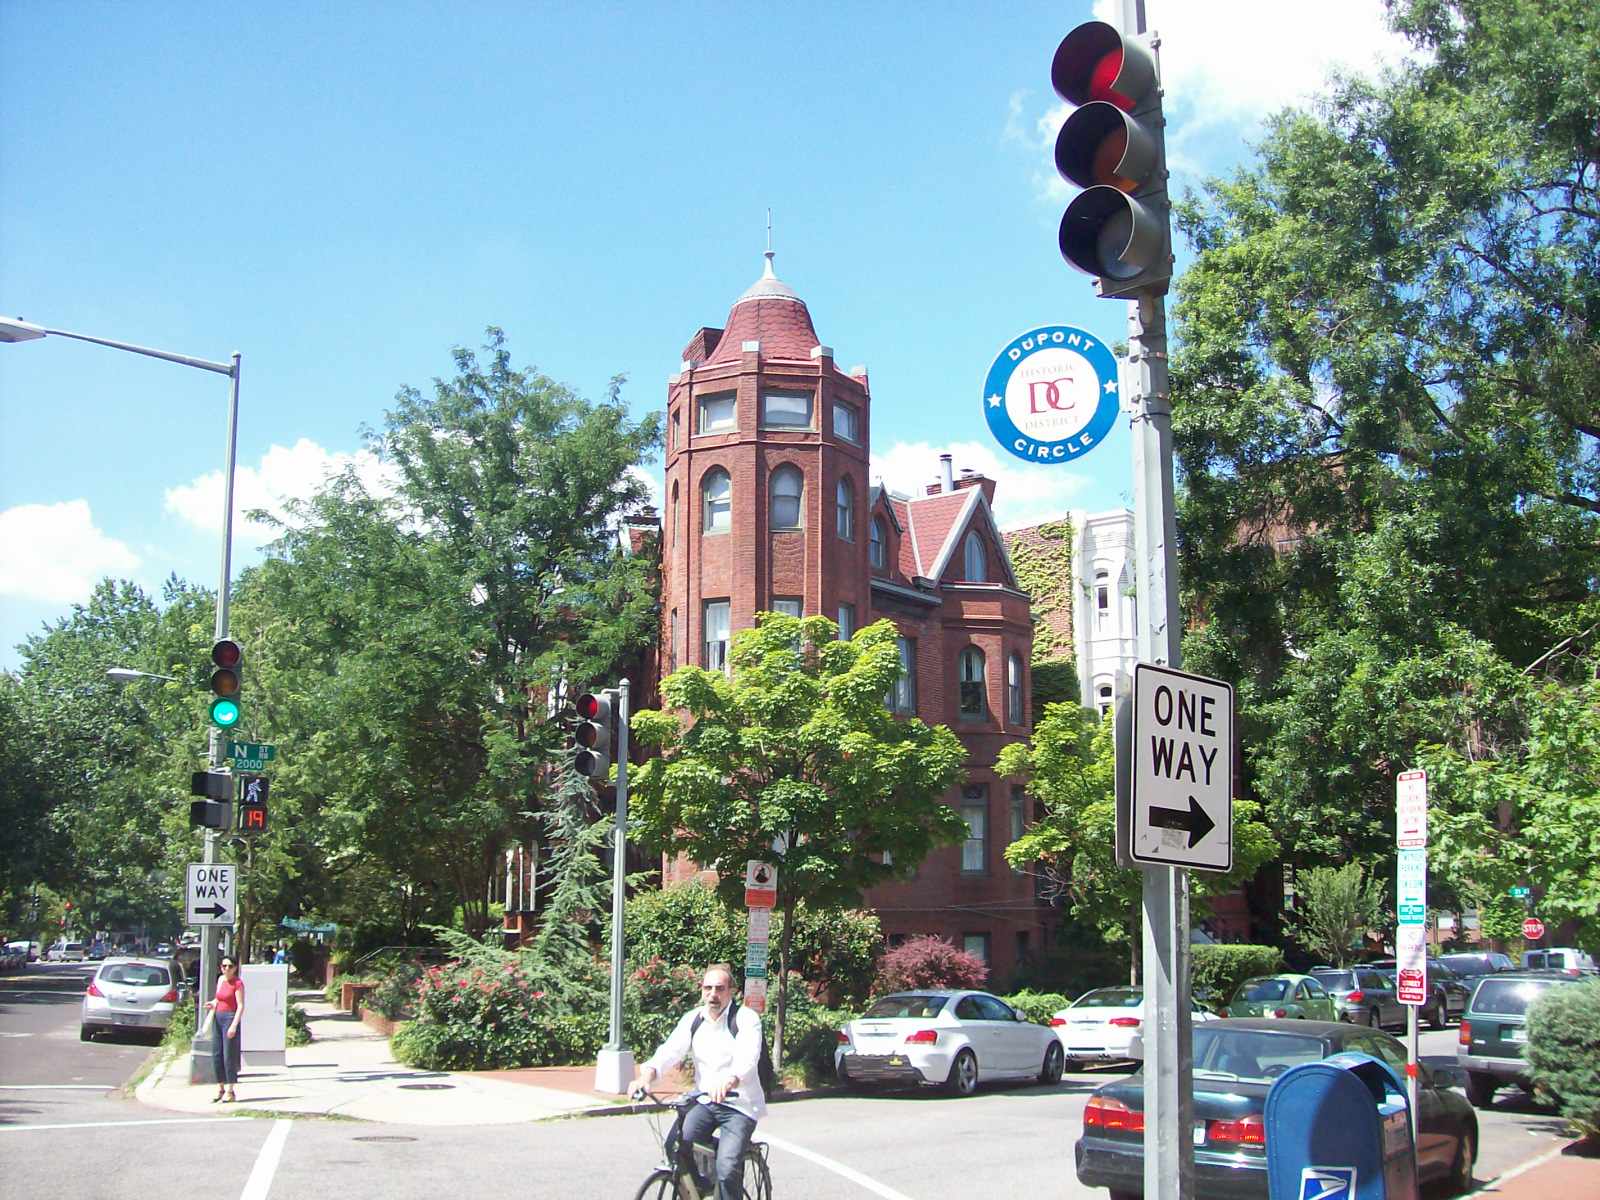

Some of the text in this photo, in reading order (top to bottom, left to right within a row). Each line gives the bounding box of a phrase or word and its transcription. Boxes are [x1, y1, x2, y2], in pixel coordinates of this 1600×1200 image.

[1008, 332, 1094, 360] DUPONT
[1021, 361, 1073, 377] HISTORIC
[1028, 378, 1075, 414] DC
[1025, 416, 1079, 431] DISTRICT
[1014, 433, 1093, 458] CIRCLE
[1154, 685, 1216, 737] ONE
[235, 745, 247, 758] N
[236, 759, 262, 769] 2000
[1151, 735, 1218, 785] WAY
[249, 810, 264, 827] 19
[197, 869, 229, 883] ONE
[195, 885, 229, 899] WAY
